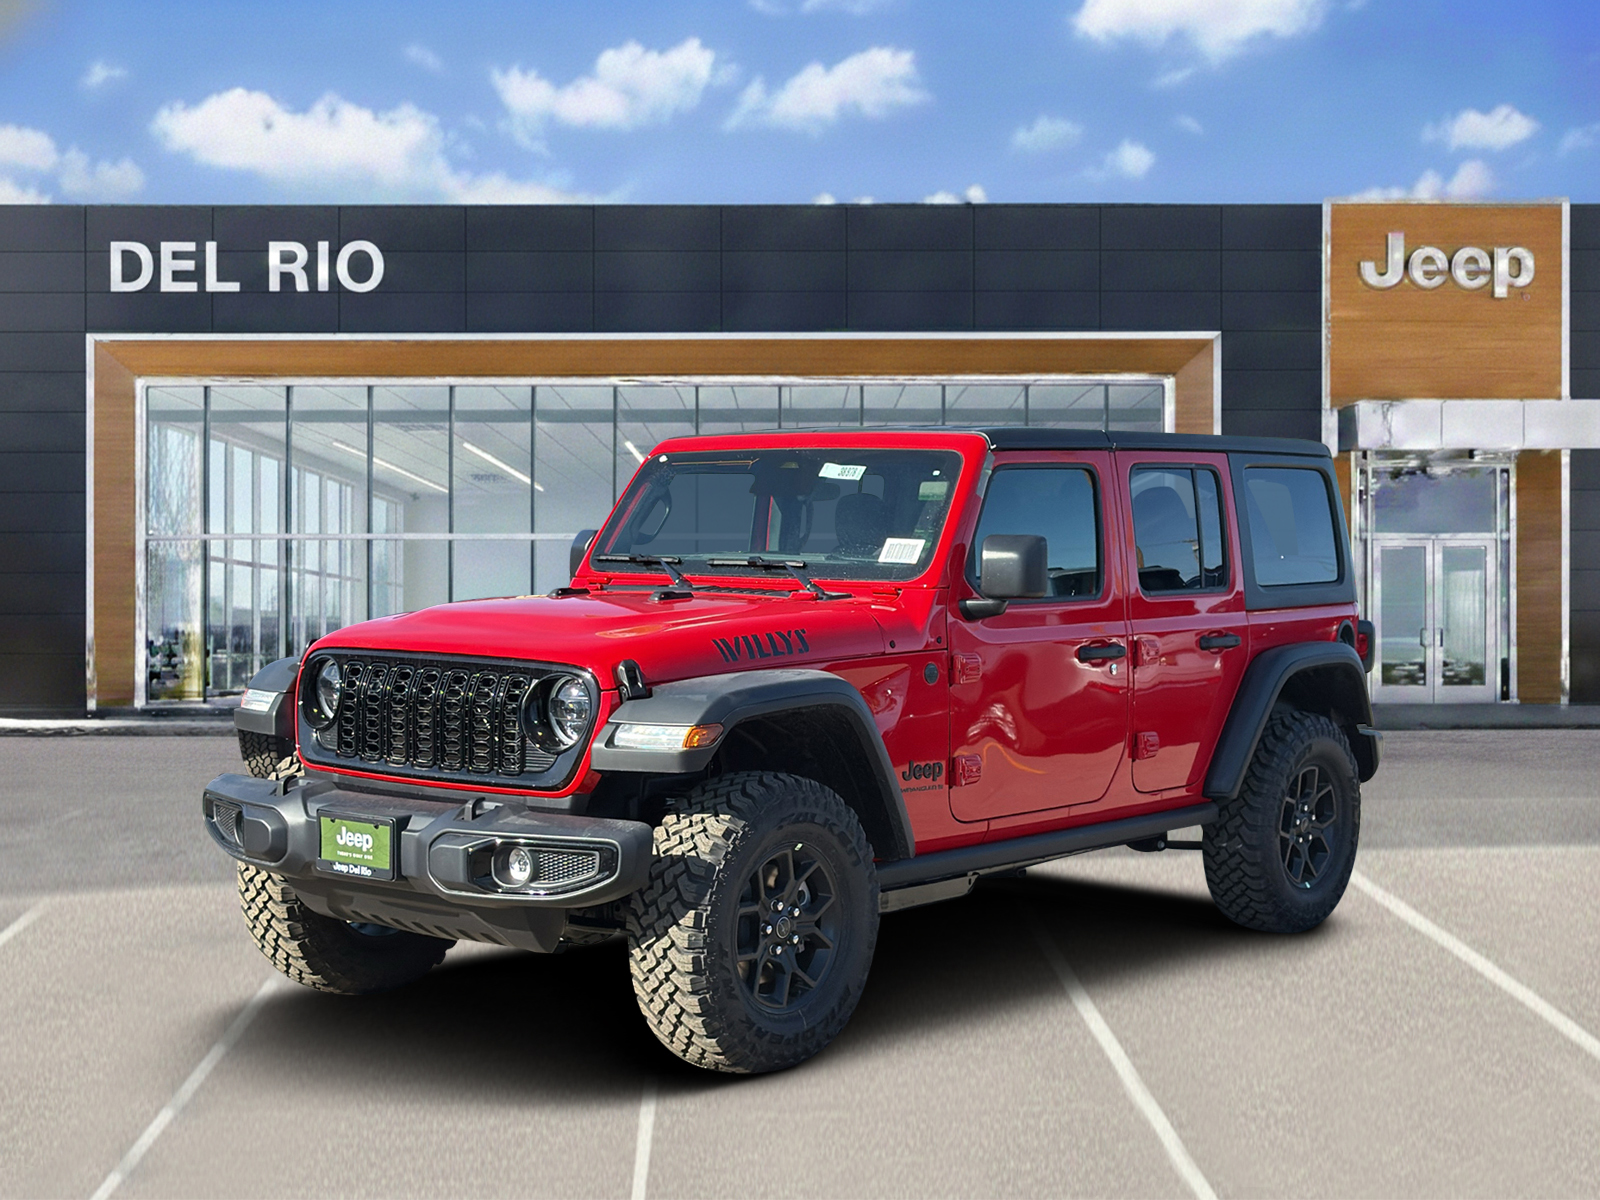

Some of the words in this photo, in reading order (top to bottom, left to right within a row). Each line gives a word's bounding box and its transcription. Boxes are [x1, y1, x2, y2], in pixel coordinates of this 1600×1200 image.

[110, 241, 240, 292] DEL
[268, 240, 385, 293] RIO
[1359, 231, 1535, 298] Jeep
[711, 628, 810, 663] WILLYS
[902, 760, 943, 781] Jeep
[336, 825, 373, 852] Jeep
[333, 861, 348, 873] Jeep
[348, 864, 360, 875] Del
[360, 865, 372, 877] Rio
